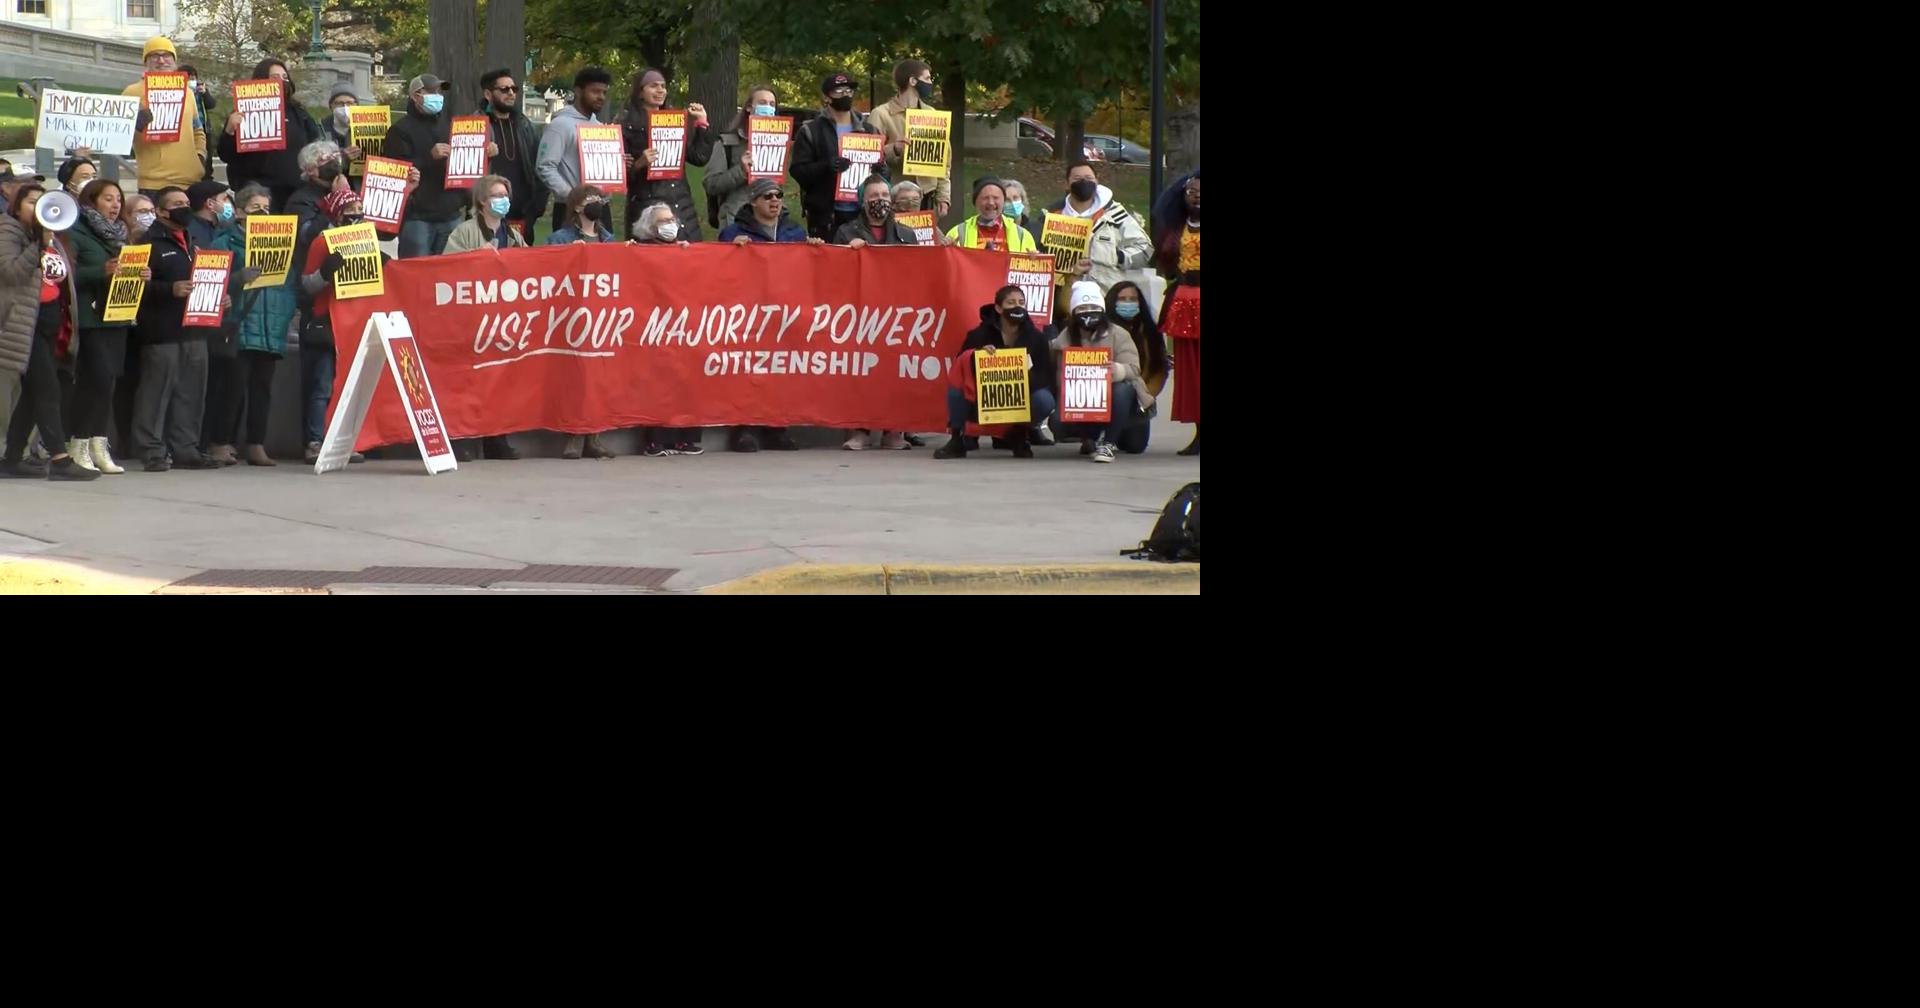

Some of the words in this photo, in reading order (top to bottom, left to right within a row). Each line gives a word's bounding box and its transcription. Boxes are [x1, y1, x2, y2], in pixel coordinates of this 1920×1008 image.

[235, 82, 280, 98] DEMOCRATS
[46, 93, 137, 119] IMMIGRANTS
[237, 97, 281, 112] CITIZENSHIP
[239, 110, 282, 139] NOW!
[451, 134, 486, 147] CITIZENSHIP
[448, 147, 485, 175] NOW!
[750, 145, 787, 172] NOW!
[907, 140, 945, 164] AHORA!
[367, 160, 409, 179] DEMOCRATS
[583, 153, 623, 180] NOW!
[365, 174, 407, 192] CITIZENSHIP
[362, 188, 404, 220] NOW!
[250, 221, 293, 235] DEMÓCRATAS
[329, 229, 373, 245] DEMÓCRATAS
[1046, 219, 1089, 236] DEMÓCRATAS
[249, 235, 292, 250] ¡CIUDADANÍA
[1044, 232, 1086, 250] ¡CIUDADANÍA
[337, 255, 379, 283] AHORA!
[1009, 257, 1052, 272] DEMOCRATS
[1008, 271, 1051, 286] CITIZENSHIP
[109, 280, 144, 305] AHORA!
[187, 282, 224, 313] NOW!
[435, 273, 620, 306] DEMOCRATS!
[473, 310, 541, 354] USE
[544, 305, 635, 349] YOUR
[640, 303, 801, 348] MAJORITY
[806, 303, 947, 349] POWER!
[704, 350, 879, 376] CITIZENSHIP
[899, 354, 952, 379] NO
[979, 355, 1024, 369] DEMÓCRATAS
[1065, 350, 1109, 365] DEMOCRATS
[980, 367, 1025, 384] ¡CIUDADANÍA
[981, 383, 1026, 408] AHORA!
[1065, 379, 1107, 408] NOW!
[414, 408, 436, 427] VOCES
